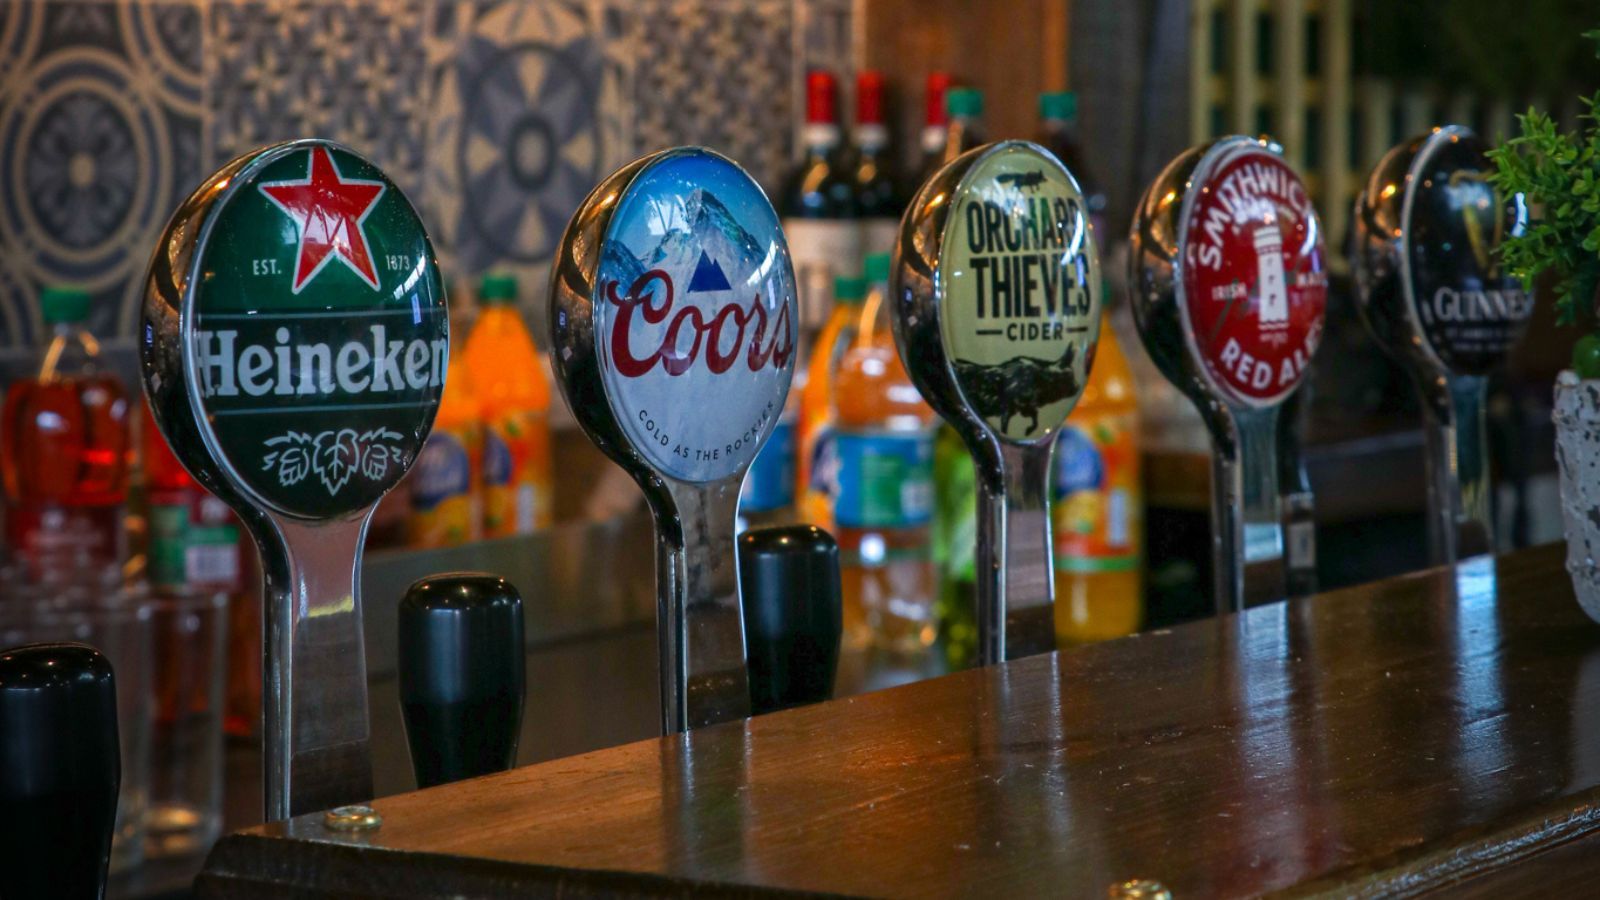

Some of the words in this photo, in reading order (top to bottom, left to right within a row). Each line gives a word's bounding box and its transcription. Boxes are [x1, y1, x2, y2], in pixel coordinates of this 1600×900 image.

[966, 197, 1086, 254] ORCHARD
[1198, 161, 1313, 271] SMITHWIC
[252, 259, 282, 275] EST.
[385, 254, 410, 271] 1873
[970, 252, 1091, 319] THIEVES
[606, 268, 793, 378] Coors
[1006, 322, 1064, 341] CIDER
[197, 324, 447, 397] Heineken
[1220, 337, 1273, 390] RED
[638, 409, 669, 445] COLD
[673, 444, 689, 459] AS
[695, 449, 719, 461] THE
[725, 400, 774, 456] ROCKIES
